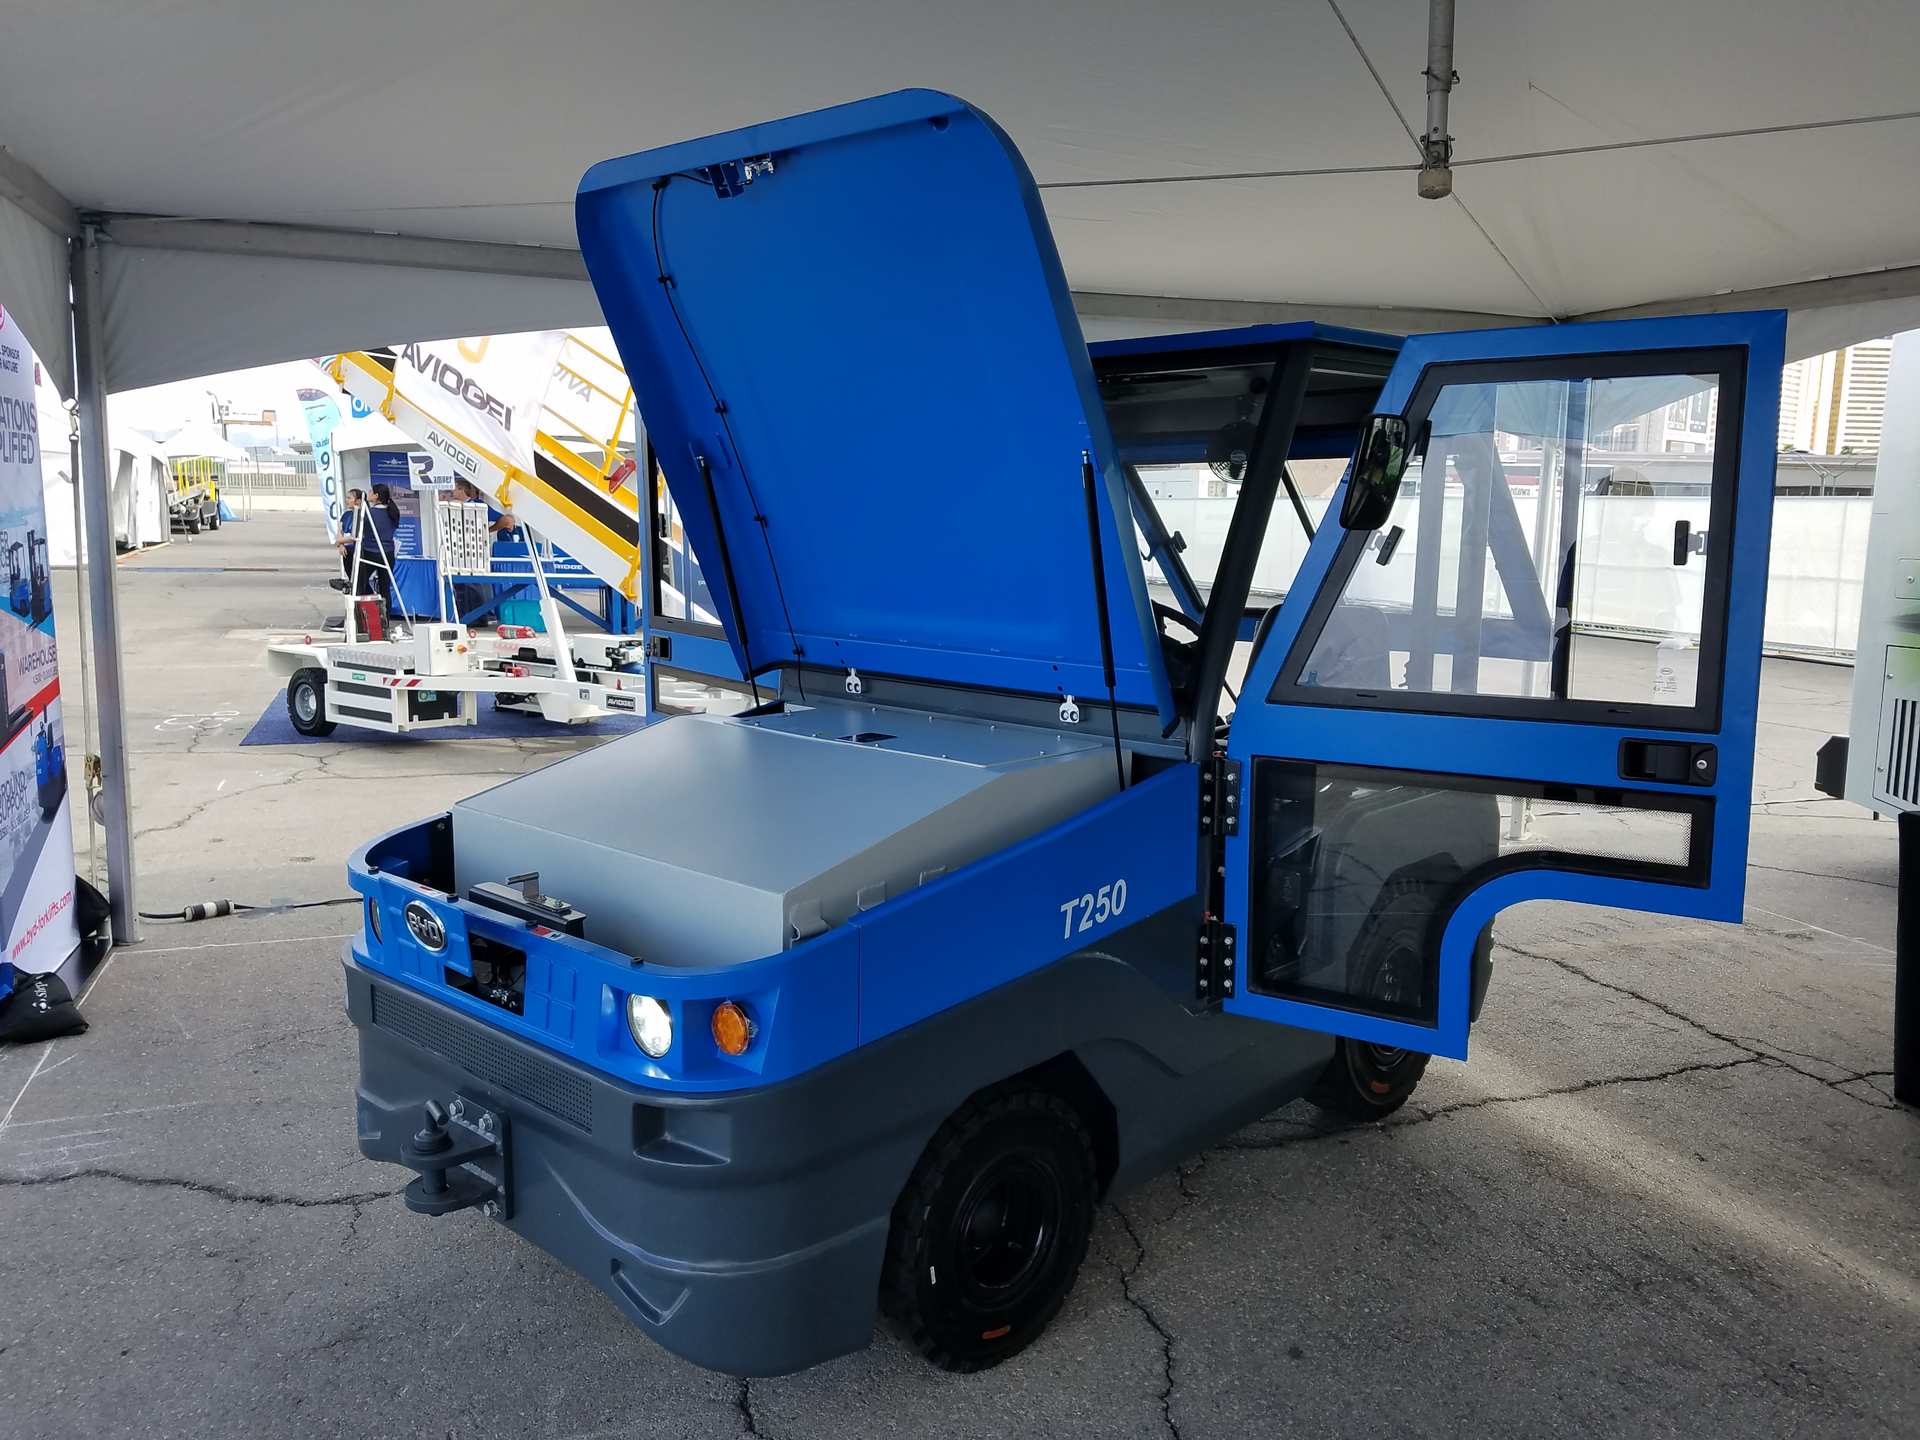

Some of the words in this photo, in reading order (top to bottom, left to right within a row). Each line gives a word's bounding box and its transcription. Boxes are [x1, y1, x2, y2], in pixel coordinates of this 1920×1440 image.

[401, 343, 513, 432] AVIOGEI
[427, 431, 479, 474] AVIOGEI
[17, 644, 57, 676] WAREHOUSE
[0, 770, 26, 799] ROUND
[12, 890, 72, 961] www.byd-forklifts.com
[407, 911, 442, 943] BYD
[1060, 878, 1127, 940] T250
